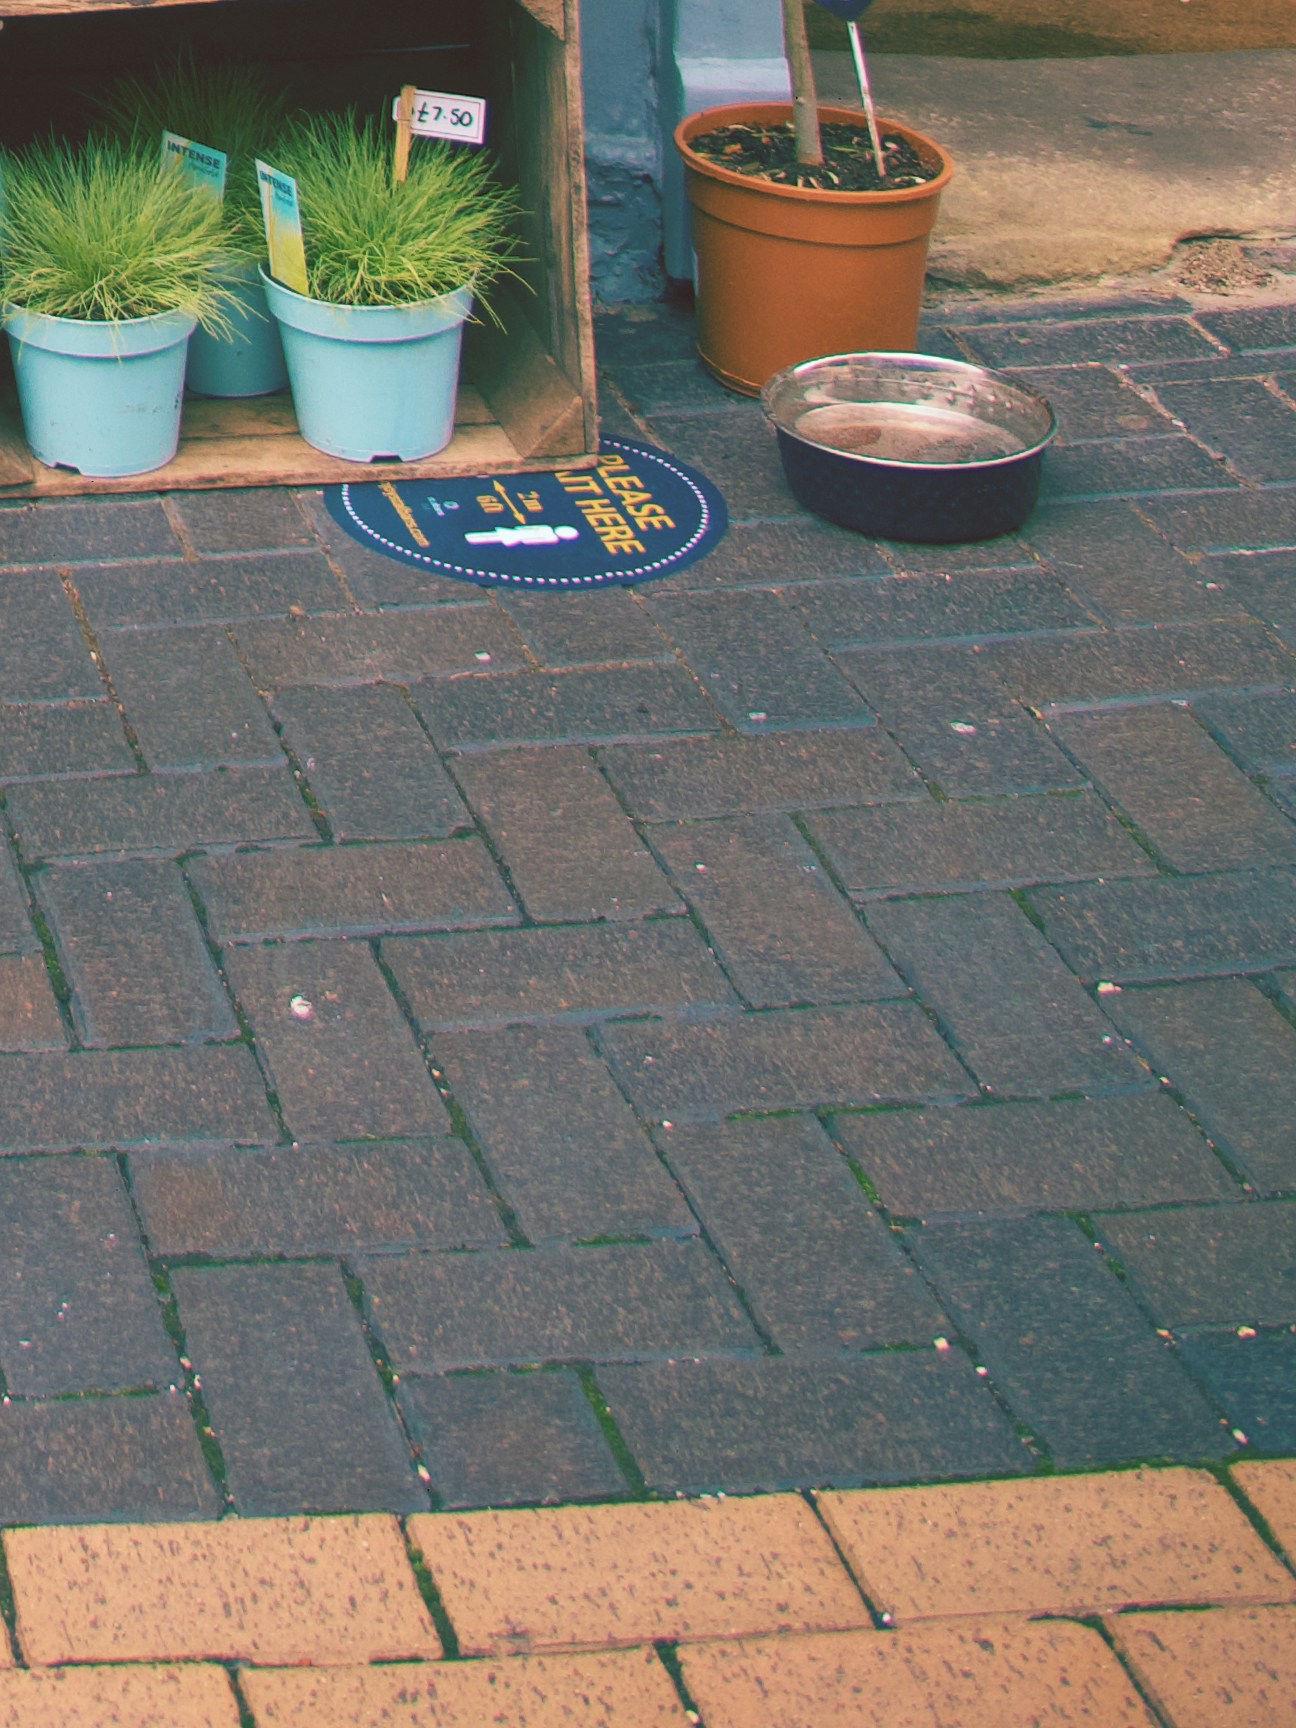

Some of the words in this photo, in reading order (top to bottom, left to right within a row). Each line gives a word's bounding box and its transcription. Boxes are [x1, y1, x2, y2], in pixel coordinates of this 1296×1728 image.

[167, 140, 220, 169] INTENSE
[259, 170, 292, 197] INTENSE
[598, 454, 676, 531] PLEASE
[575, 499, 647, 555] HERE
